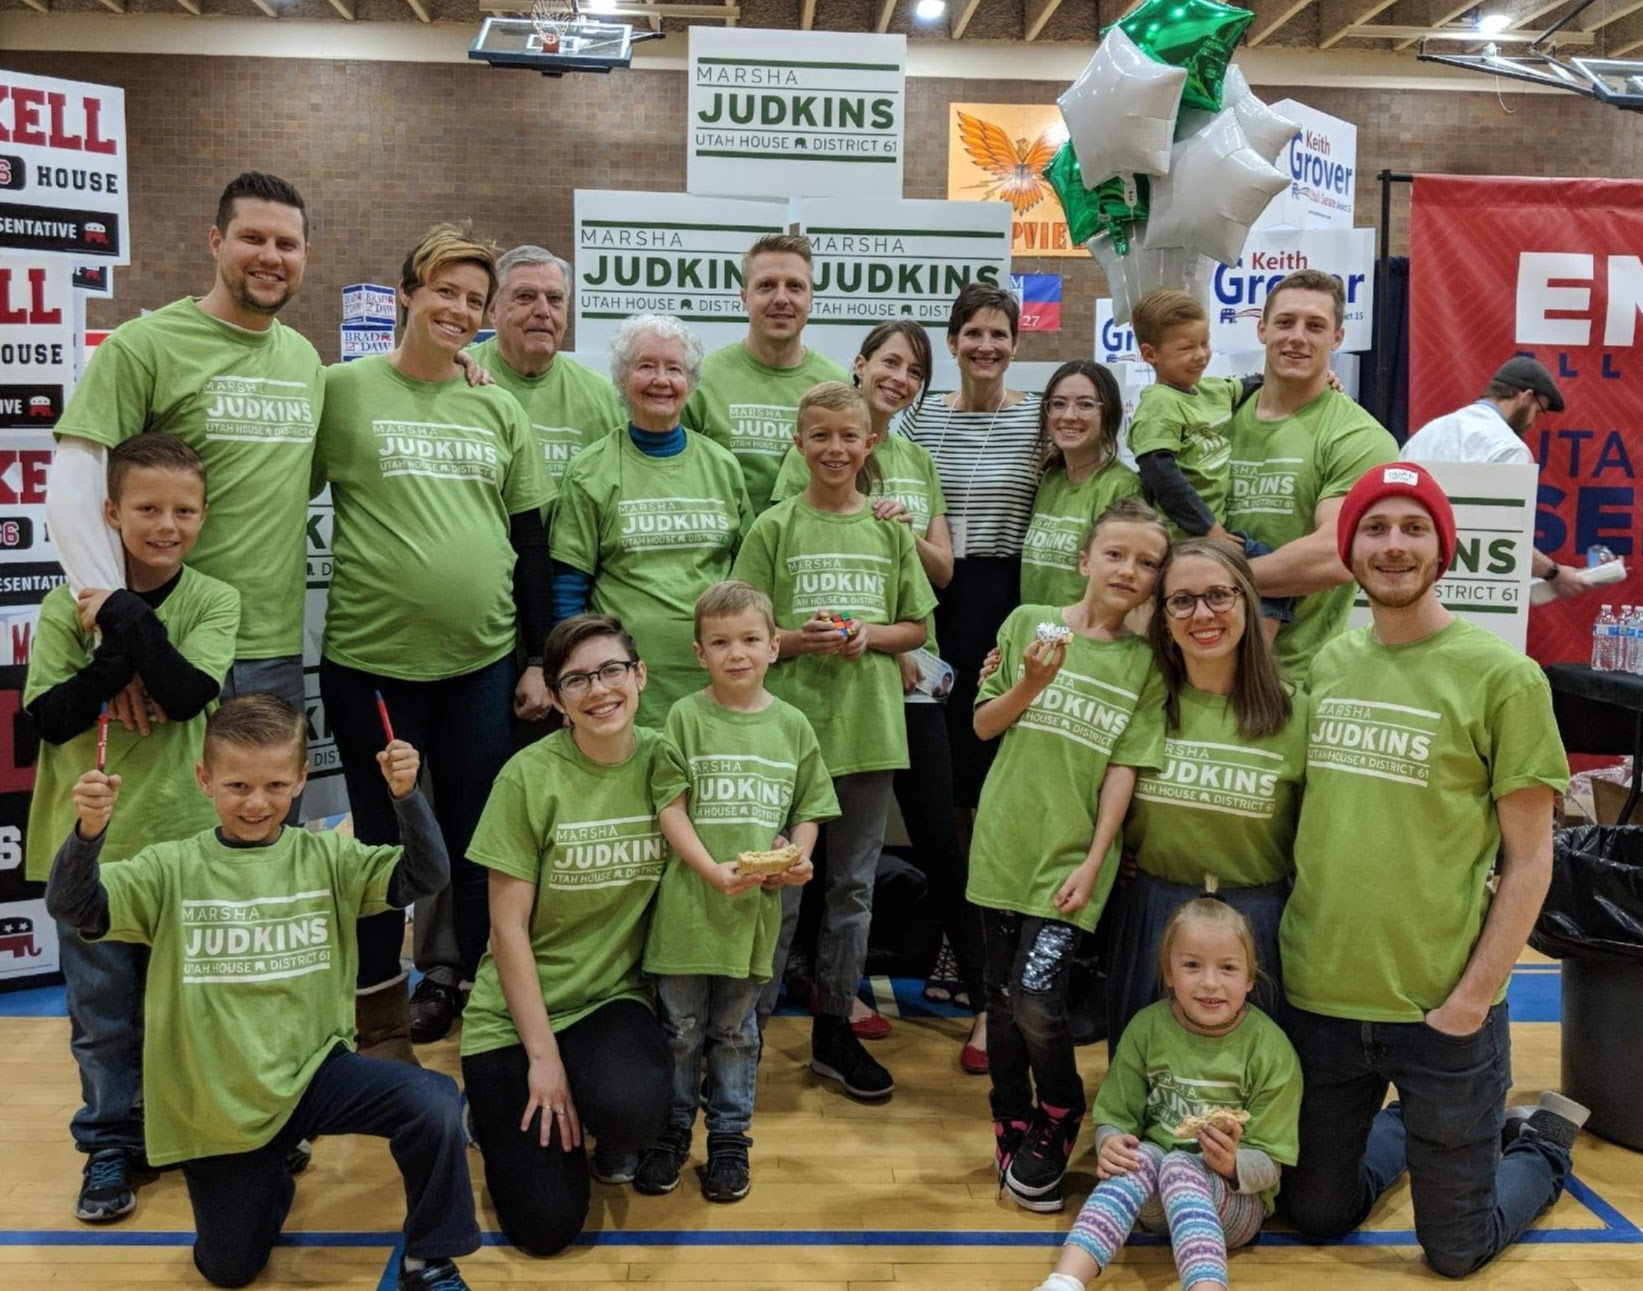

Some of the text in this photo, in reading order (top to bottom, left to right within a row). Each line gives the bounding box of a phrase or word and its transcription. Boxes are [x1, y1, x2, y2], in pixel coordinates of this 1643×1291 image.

[697, 66, 799, 85] MARSHA
[698, 93, 895, 129] JUDKINS
[0, 85, 117, 155] ELL
[696, 134, 897, 152] UTAH HOUSE DISTRICT 61
[1306, 129, 1331, 156] Keith
[1290, 131, 1352, 195] Grover
[37, 165, 119, 194] HOUSE
[581, 229, 683, 247] MARSHA
[811, 236, 905, 253] MARSHA
[1252, 250, 1308, 270] Keith
[582, 255, 744, 289] JUDKIN
[581, 296, 748, 313] UTAH HOUSE DISTR
[847, 303, 896, 317] HOUSE
[1022, 315, 1040, 327] 27
[1355, 312, 1364, 320] 15
[344, 332, 380, 341] BRAD
[361, 342, 391, 351] DAW
[207, 396, 313, 422] JUDKINS
[729, 408, 782, 418] MARSHA
[206, 423, 233, 433] UTAH
[236, 424, 264, 435] HOUSE
[373, 425, 438, 436] MARSHA
[379, 437, 497, 464] JUDKINS
[730, 440, 779, 450] UTAH HOUSE
[380, 460, 408, 471] UTAH
[409, 461, 439, 472] HOUSE
[1231, 465, 1258, 475] SHA
[619, 502, 676, 513] MARSHA
[622, 514, 729, 534] JUDKINS
[622, 537, 645, 547] UTAH
[647, 535, 675, 545] HOUSE
[788, 559, 841, 574] MARSHA
[810, 596, 839, 605] HOUSE
[1502, 588, 1519, 600] 61
[1317, 703, 1371, 719] MARSHA
[1026, 712, 1114, 747] HOUSE DISTRICT
[1311, 721, 1431, 761] JUDKINS
[1308, 749, 1429, 779] UTAH HOUSE DISTRICT 61
[697, 777, 793, 806] UDKINS
[1136, 782, 1156, 793] TAH
[1159, 786, 1197, 800] HOUSE
[1214, 795, 1264, 811] DISTRICT
[704, 806, 738, 817] HOUSE
[556, 826, 618, 841] MARSHA
[550, 873, 580, 884] UTAH
[581, 871, 612, 882] HOUSE
[183, 907, 260, 921] MARSHA
[186, 918, 328, 956] JUDKINS
[184, 950, 330, 974] UTAH HOUSE DISTRICT 61
